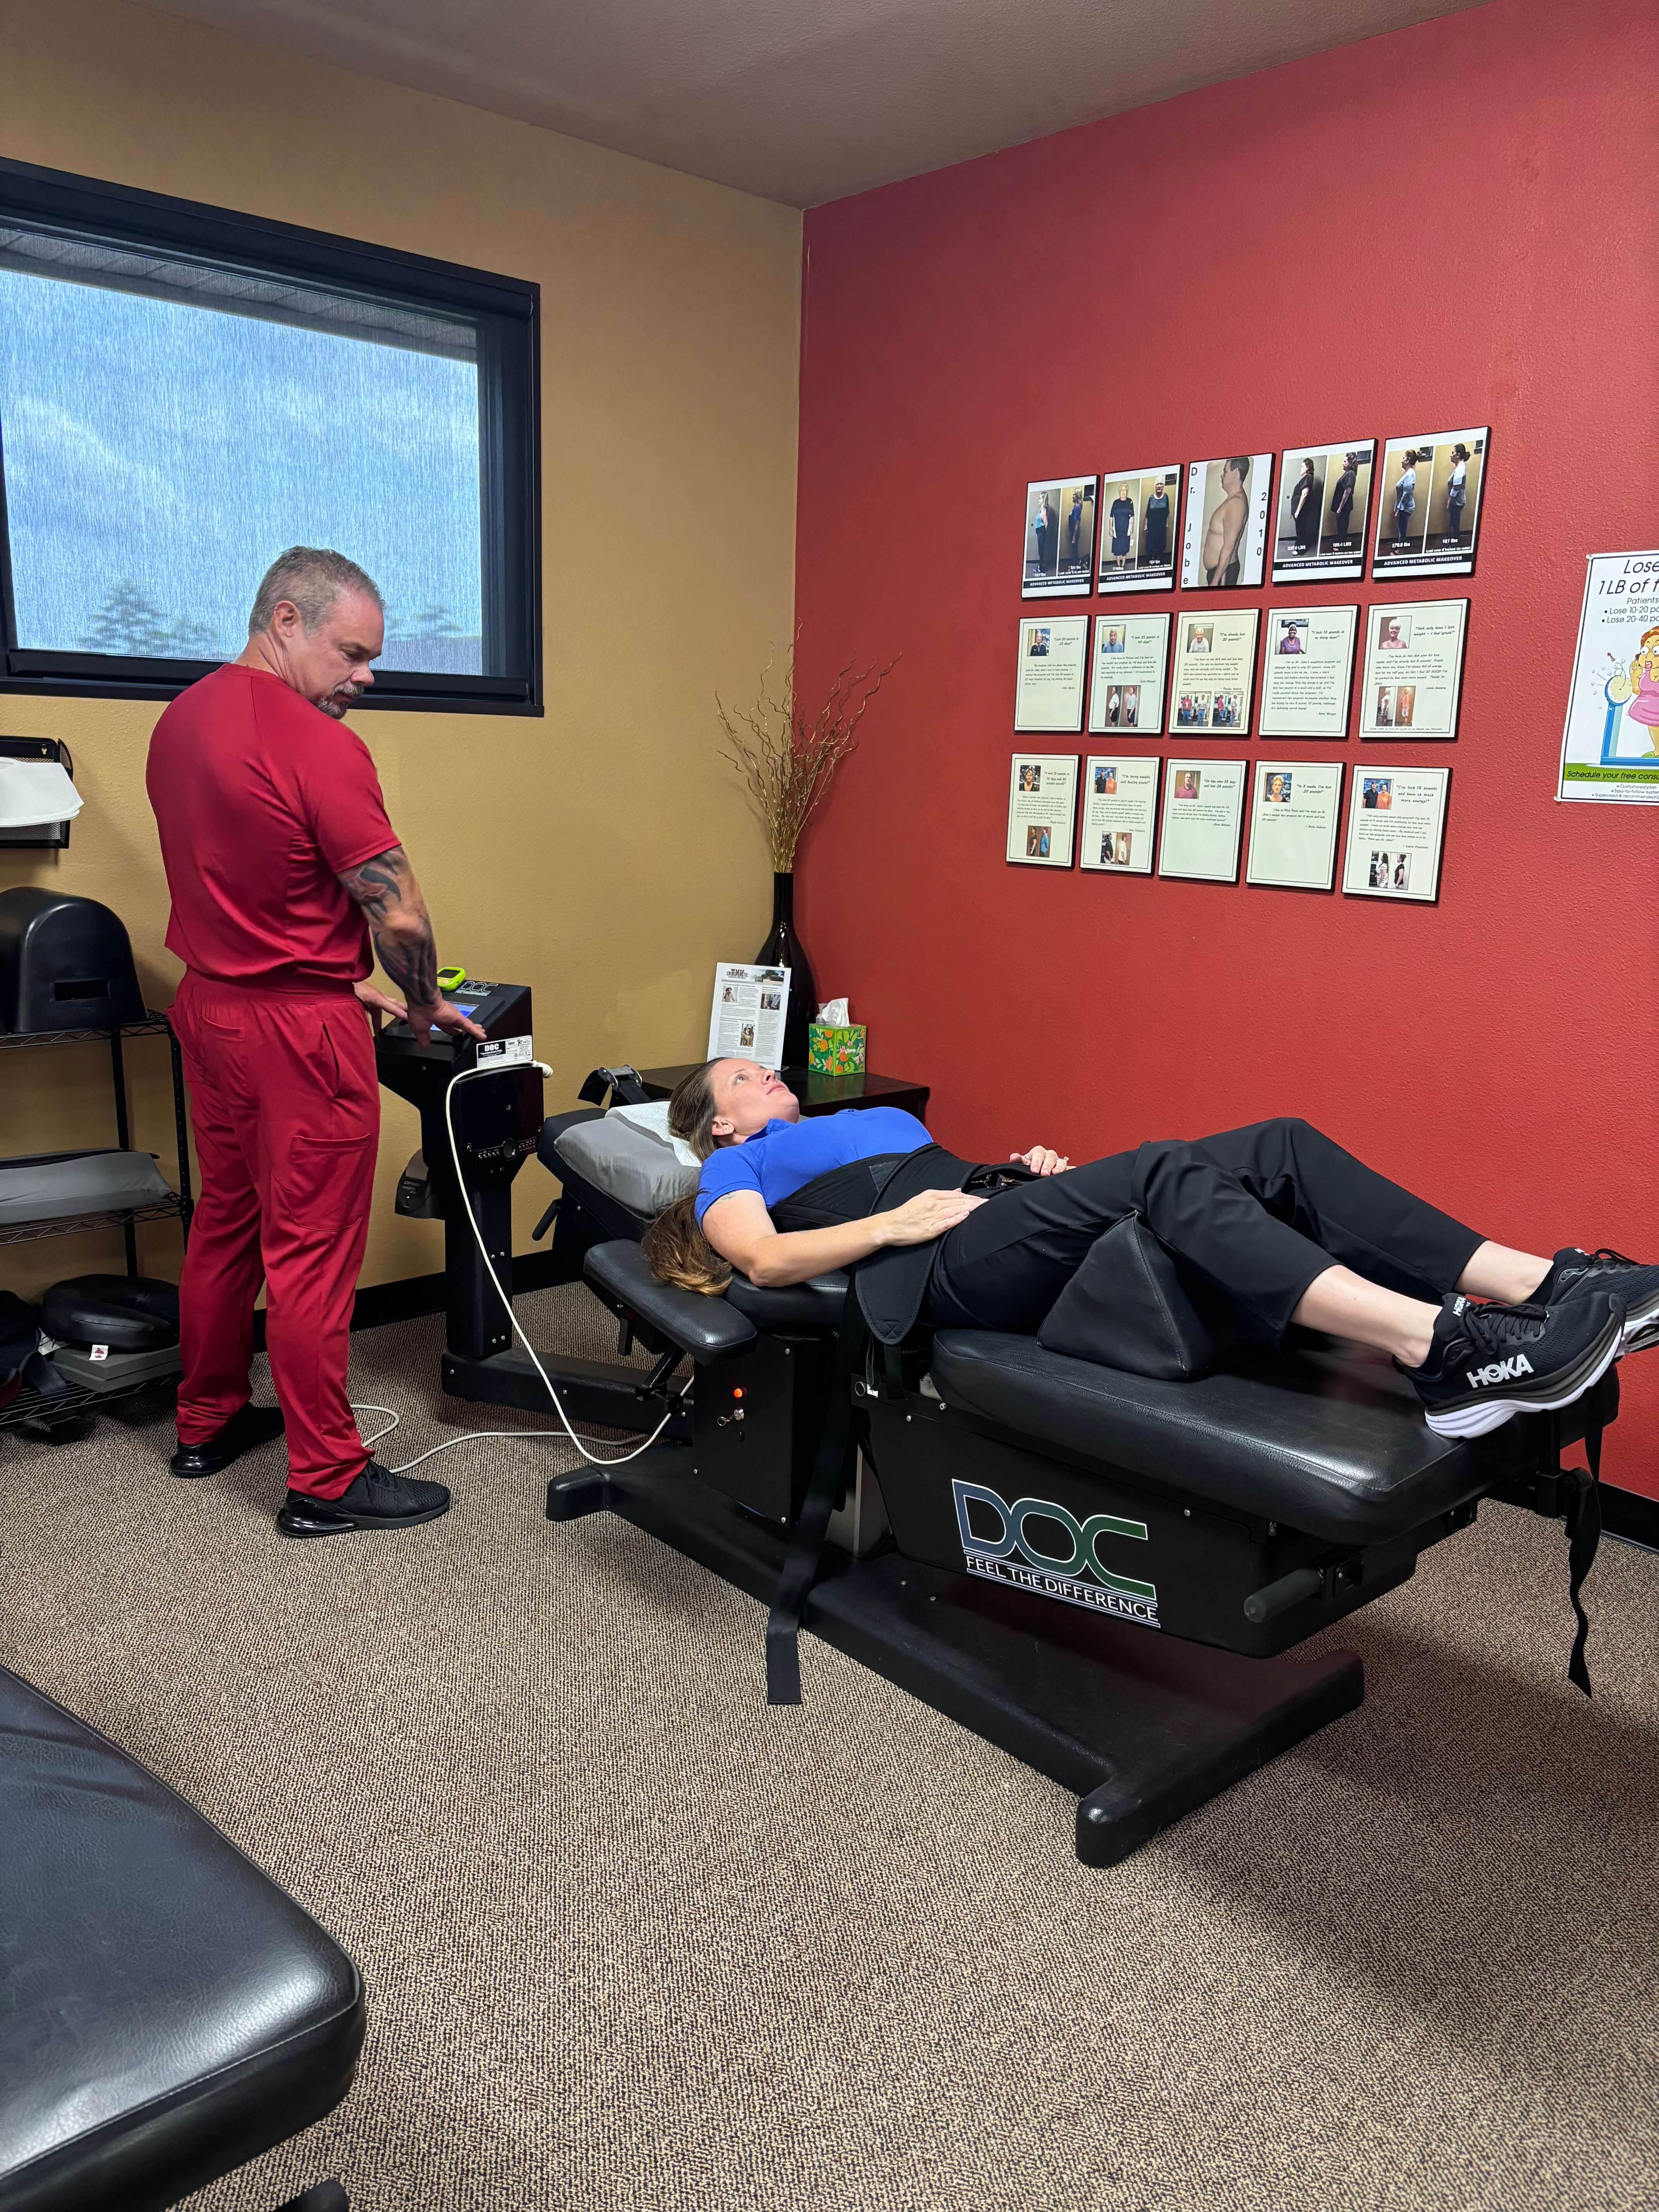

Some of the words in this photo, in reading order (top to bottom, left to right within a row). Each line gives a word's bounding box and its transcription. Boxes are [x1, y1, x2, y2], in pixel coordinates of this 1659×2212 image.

[1623, 559, 1659, 574] Lose
[1630, 578, 1650, 593] of
[484, 1043, 499, 1052] DOC
[1453, 1296, 1467, 1316] HOKA
[1466, 1353, 1534, 1388] HOKA
[952, 1478, 1156, 1601] DOC
[966, 1556, 1006, 1578] FEEL
[1007, 1567, 1042, 1589] THE
[1045, 1578, 1158, 1621] DIFFERENCE
